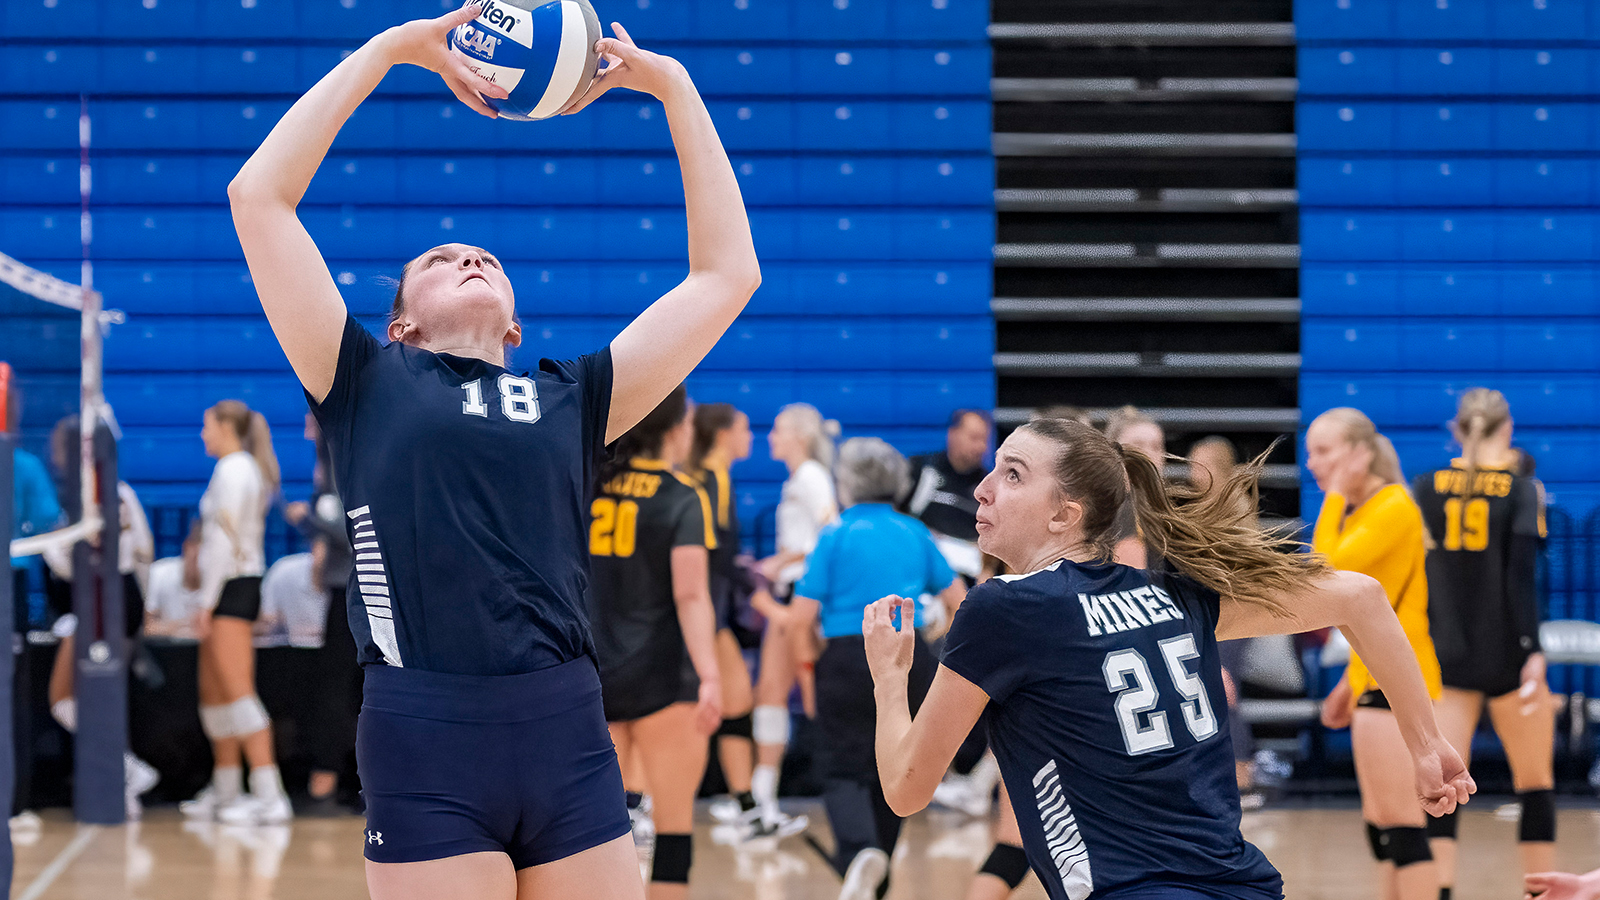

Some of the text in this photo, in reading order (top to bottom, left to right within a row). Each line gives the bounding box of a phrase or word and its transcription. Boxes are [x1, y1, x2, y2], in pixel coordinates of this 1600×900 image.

[453, 22, 497, 60] NCAA
[464, 0, 516, 33] lten
[469, 65, 497, 83] Tuch
[461, 372, 541, 424] 18
[1433, 469, 1514, 498] WOVES
[589, 497, 639, 557] 20
[1443, 497, 1490, 551] 19
[1077, 584, 1185, 637] MINES
[1101, 632, 1219, 757] 25
